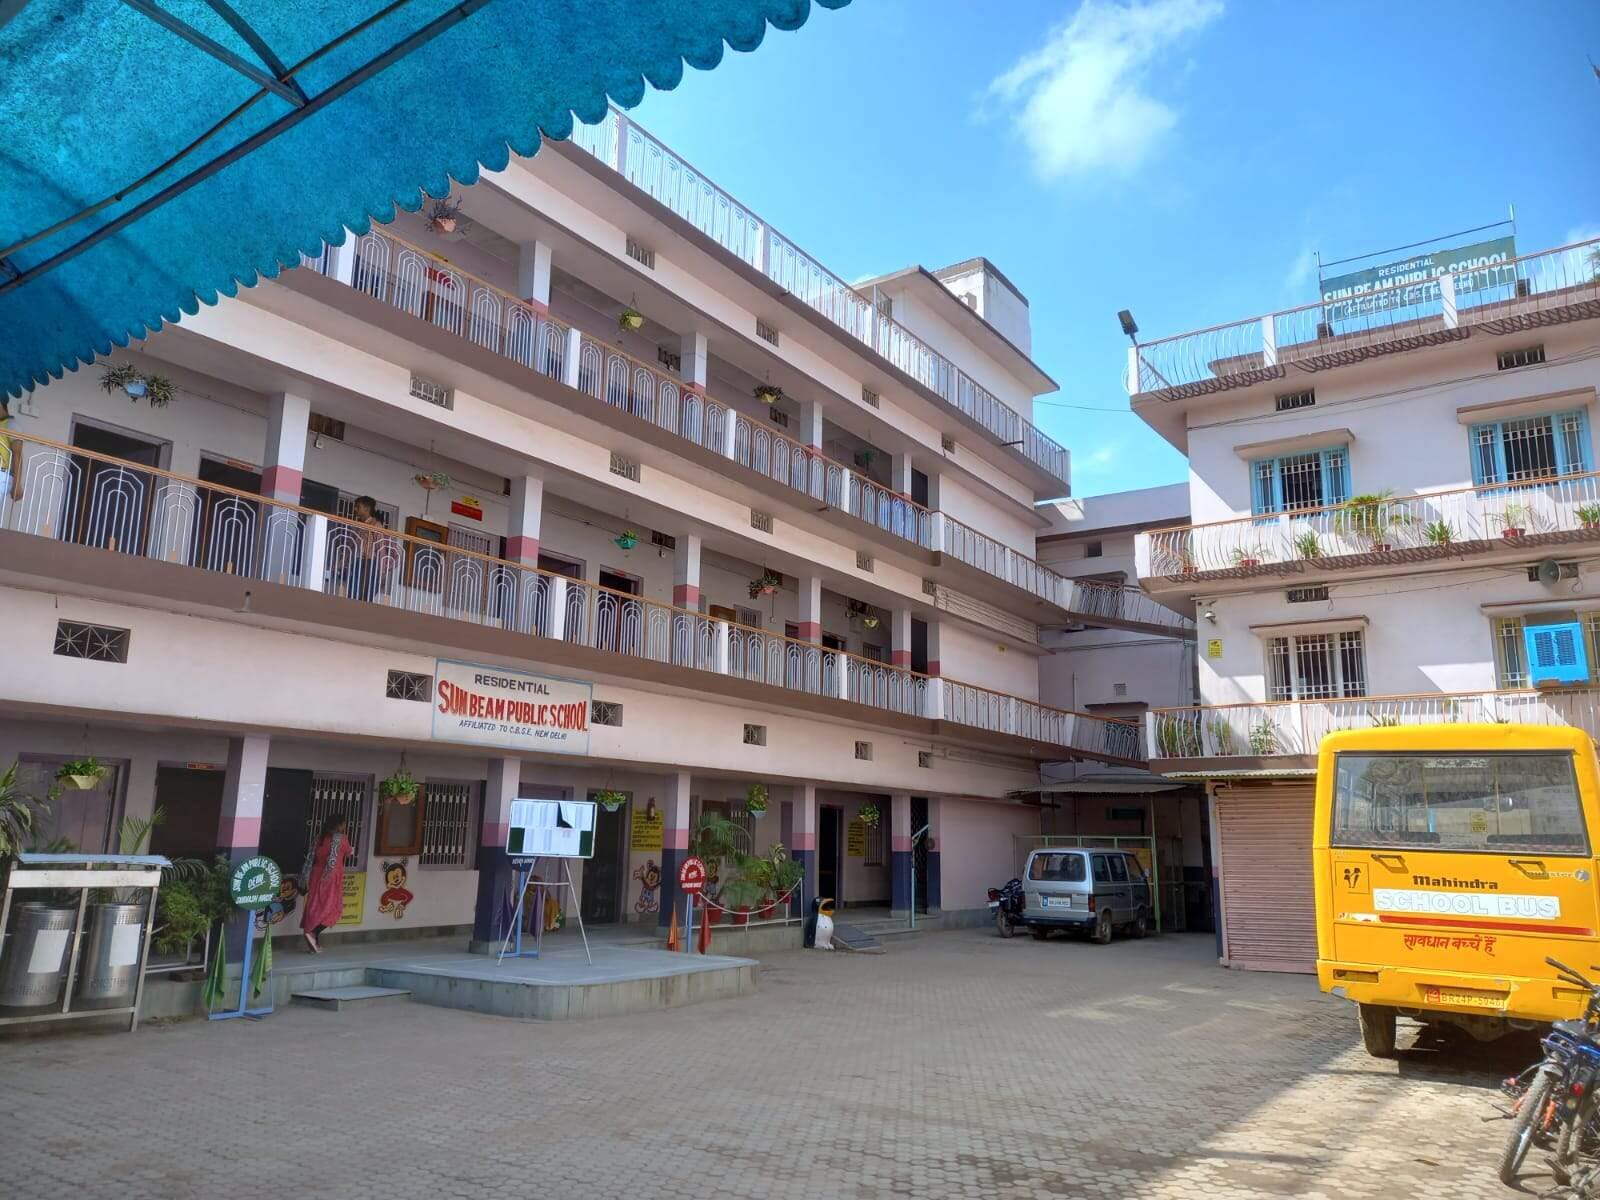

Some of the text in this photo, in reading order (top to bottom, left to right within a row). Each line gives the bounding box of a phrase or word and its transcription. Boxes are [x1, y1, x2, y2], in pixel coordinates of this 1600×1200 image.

[1378, 258, 1435, 277] RESIDENTIAL
[1450, 252, 1515, 282] SCHOOL
[474, 673, 551, 696] RESIDENTIAL
[438, 679, 588, 732] SUN BEAM PUBLIC SCHOOL
[459, 719, 496, 732] AFFILIATED
[499, 724, 508, 733] TO
[534, 729, 550, 739] NEW
[550, 731, 568, 741] DELHI
[1375, 890, 1558, 918] SCHOOL BUS
[1403, 934, 1449, 951] सावधान
